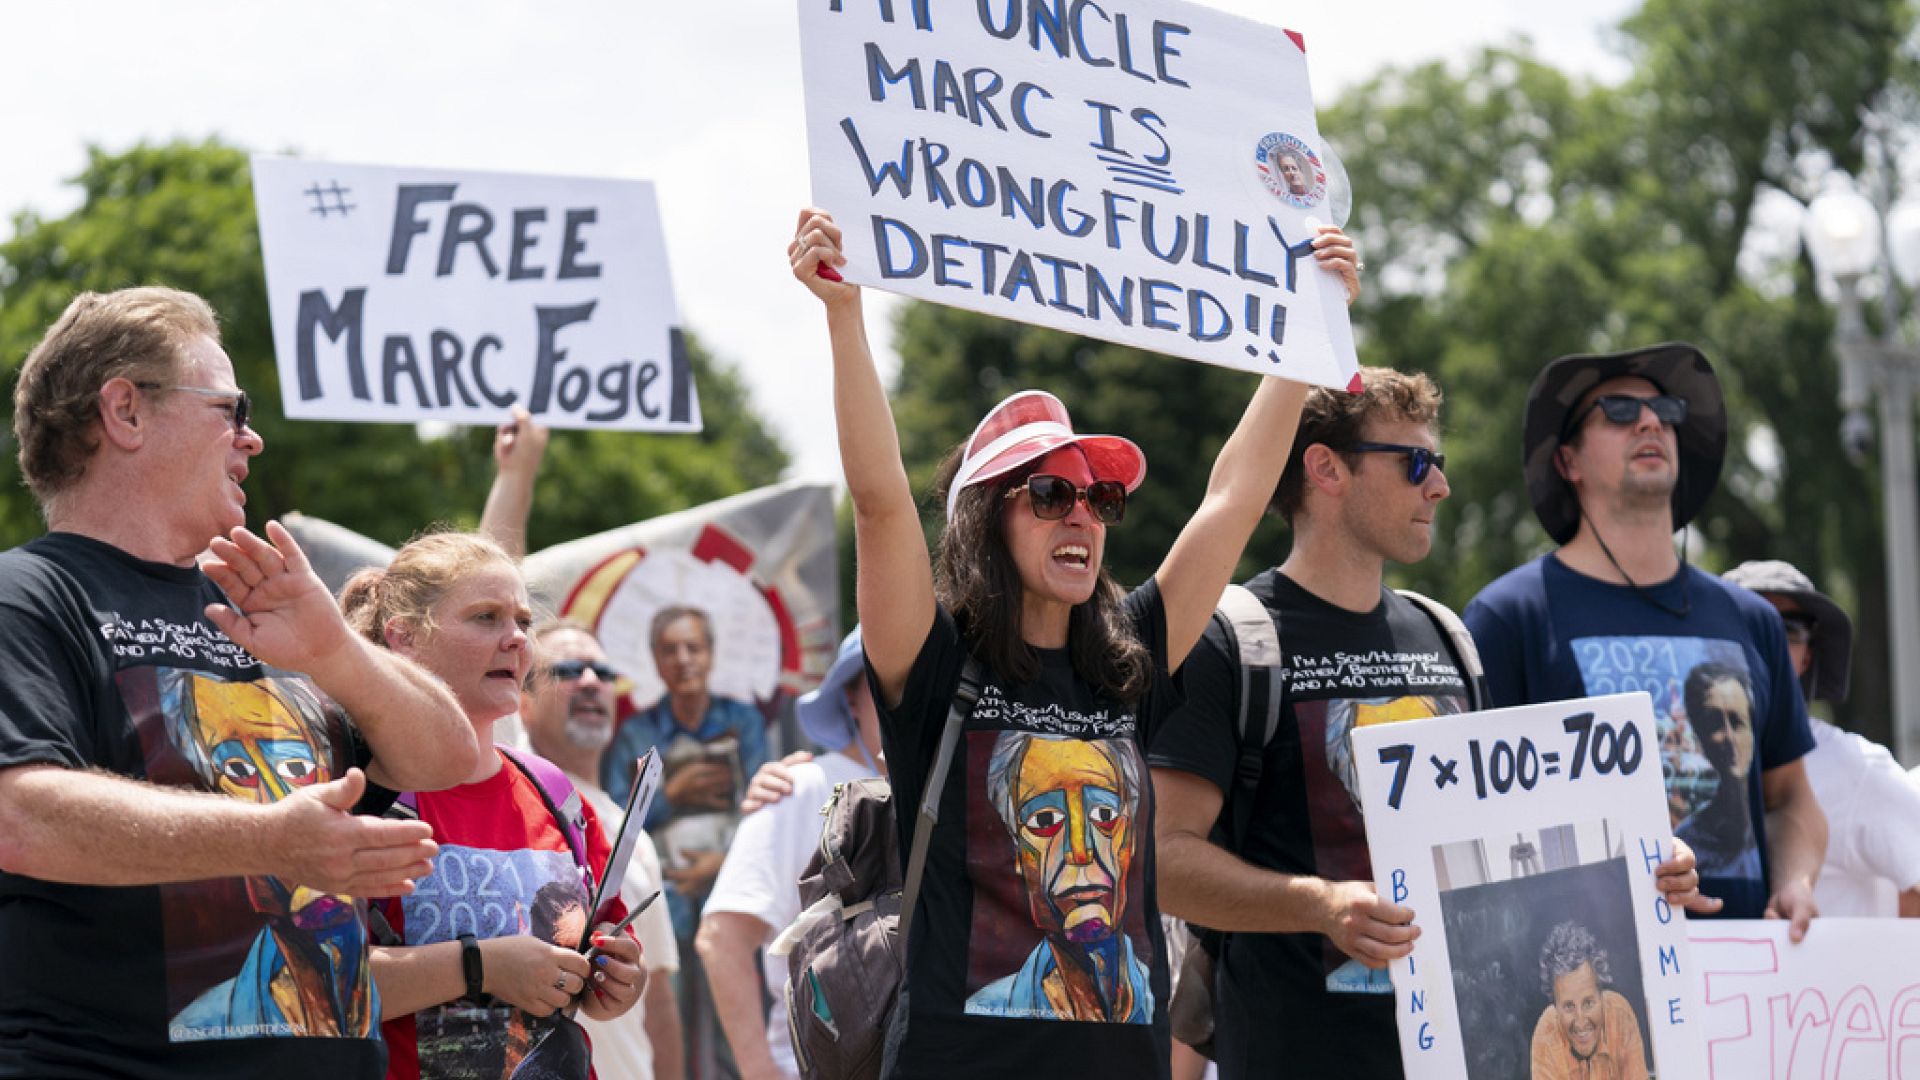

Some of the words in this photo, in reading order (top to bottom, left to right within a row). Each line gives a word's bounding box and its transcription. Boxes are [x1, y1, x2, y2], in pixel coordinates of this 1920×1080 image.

[976, 0, 1191, 88] UNCLE
[865, 42, 1052, 138] MARC
[1084, 100, 1170, 166] IS
[385, 183, 603, 281] FREE
[840, 117, 1315, 293] WRONGFULLY
[872, 214, 1286, 363] DETAINED!!
[297, 287, 518, 409] MARC
[1340, 675, 1365, 687] 40
[1583, 641, 1679, 675] 2021
[1378, 744, 1415, 809] 7
